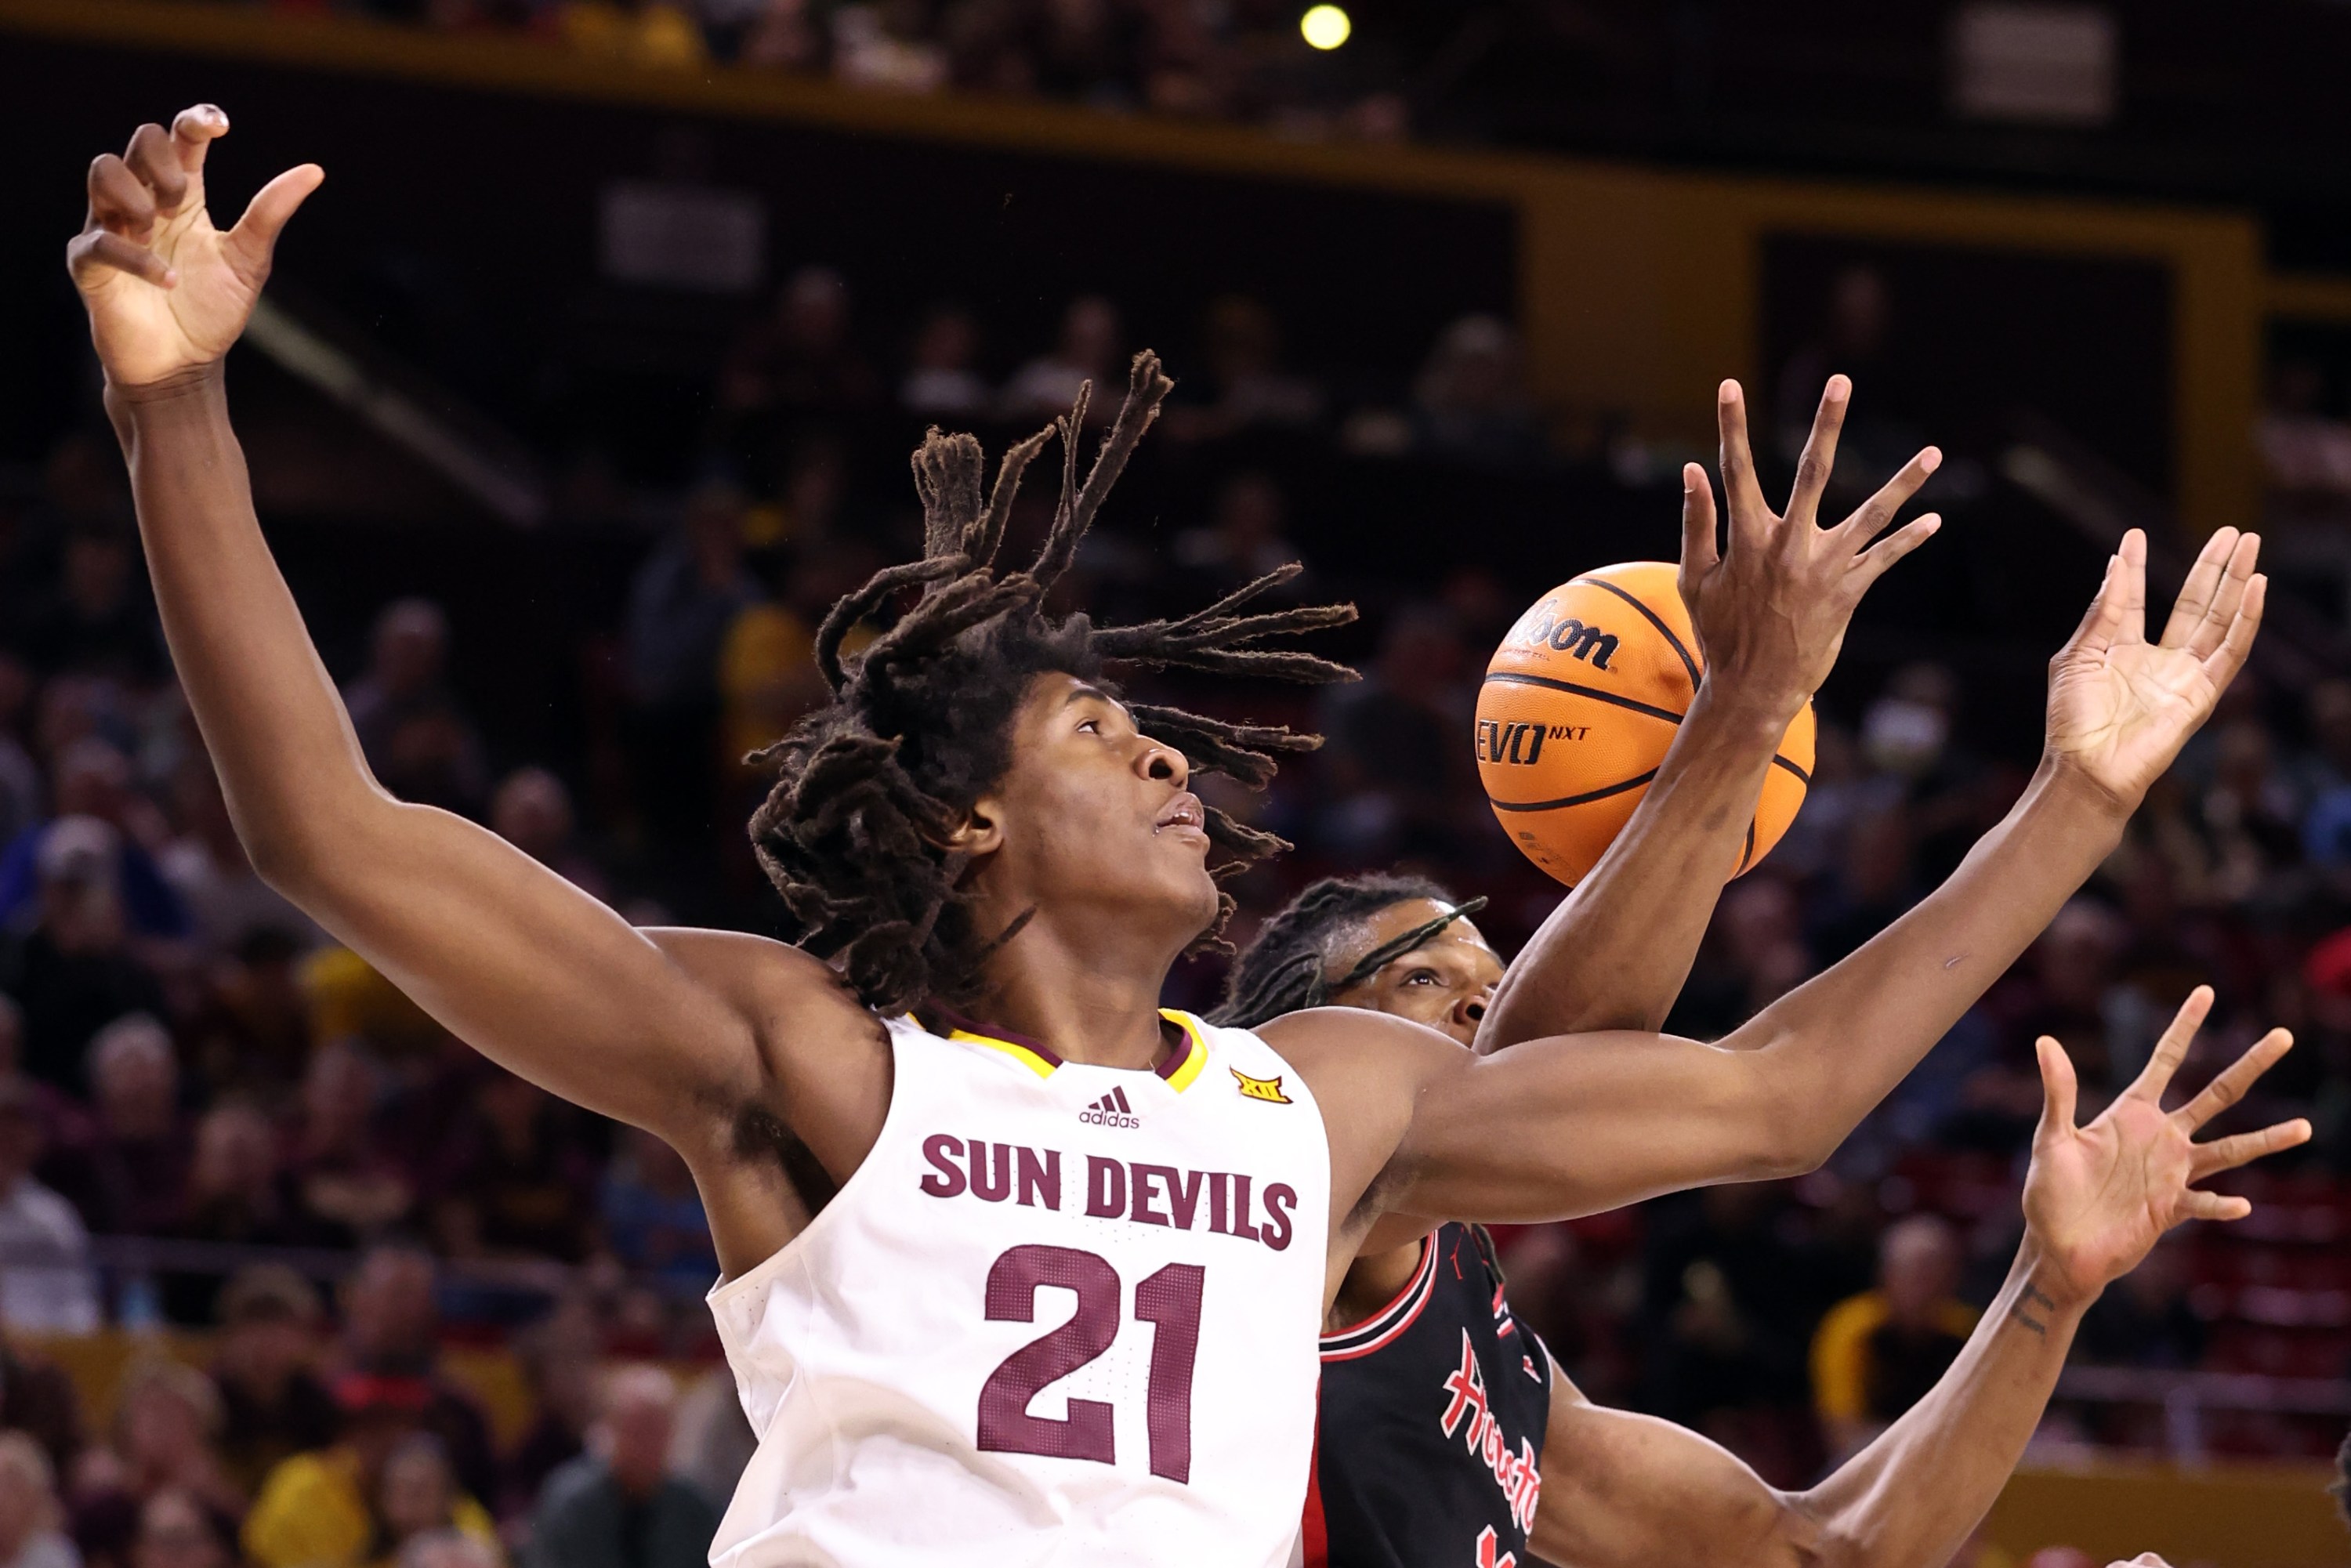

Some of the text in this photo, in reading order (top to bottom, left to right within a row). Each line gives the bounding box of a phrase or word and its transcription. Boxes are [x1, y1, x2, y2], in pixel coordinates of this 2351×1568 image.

[1476, 719, 1591, 766] EVO NXT
[1079, 1110, 1139, 1129] adidas
[920, 1134, 1299, 1251] SUN DEVILS
[977, 1244, 1206, 1485] 21
